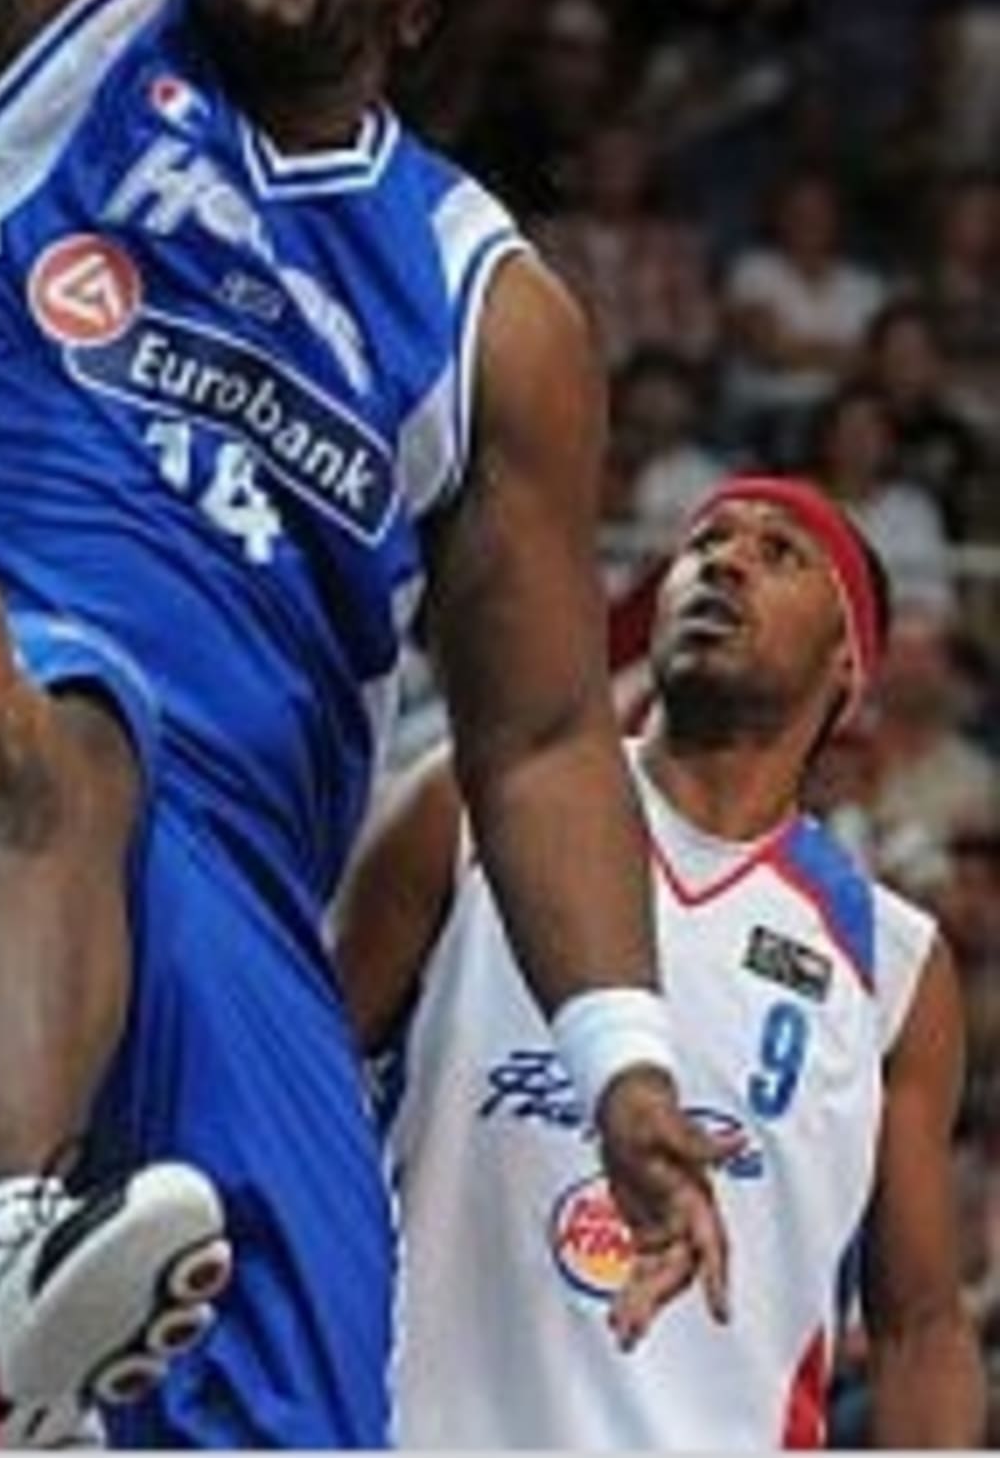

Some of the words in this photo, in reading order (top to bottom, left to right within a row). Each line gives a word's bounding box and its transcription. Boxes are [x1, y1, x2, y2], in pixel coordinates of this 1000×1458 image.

[129, 332, 378, 511] Eurobank
[145, 418, 283, 564] 14
[747, 1002, 812, 1121] 9
